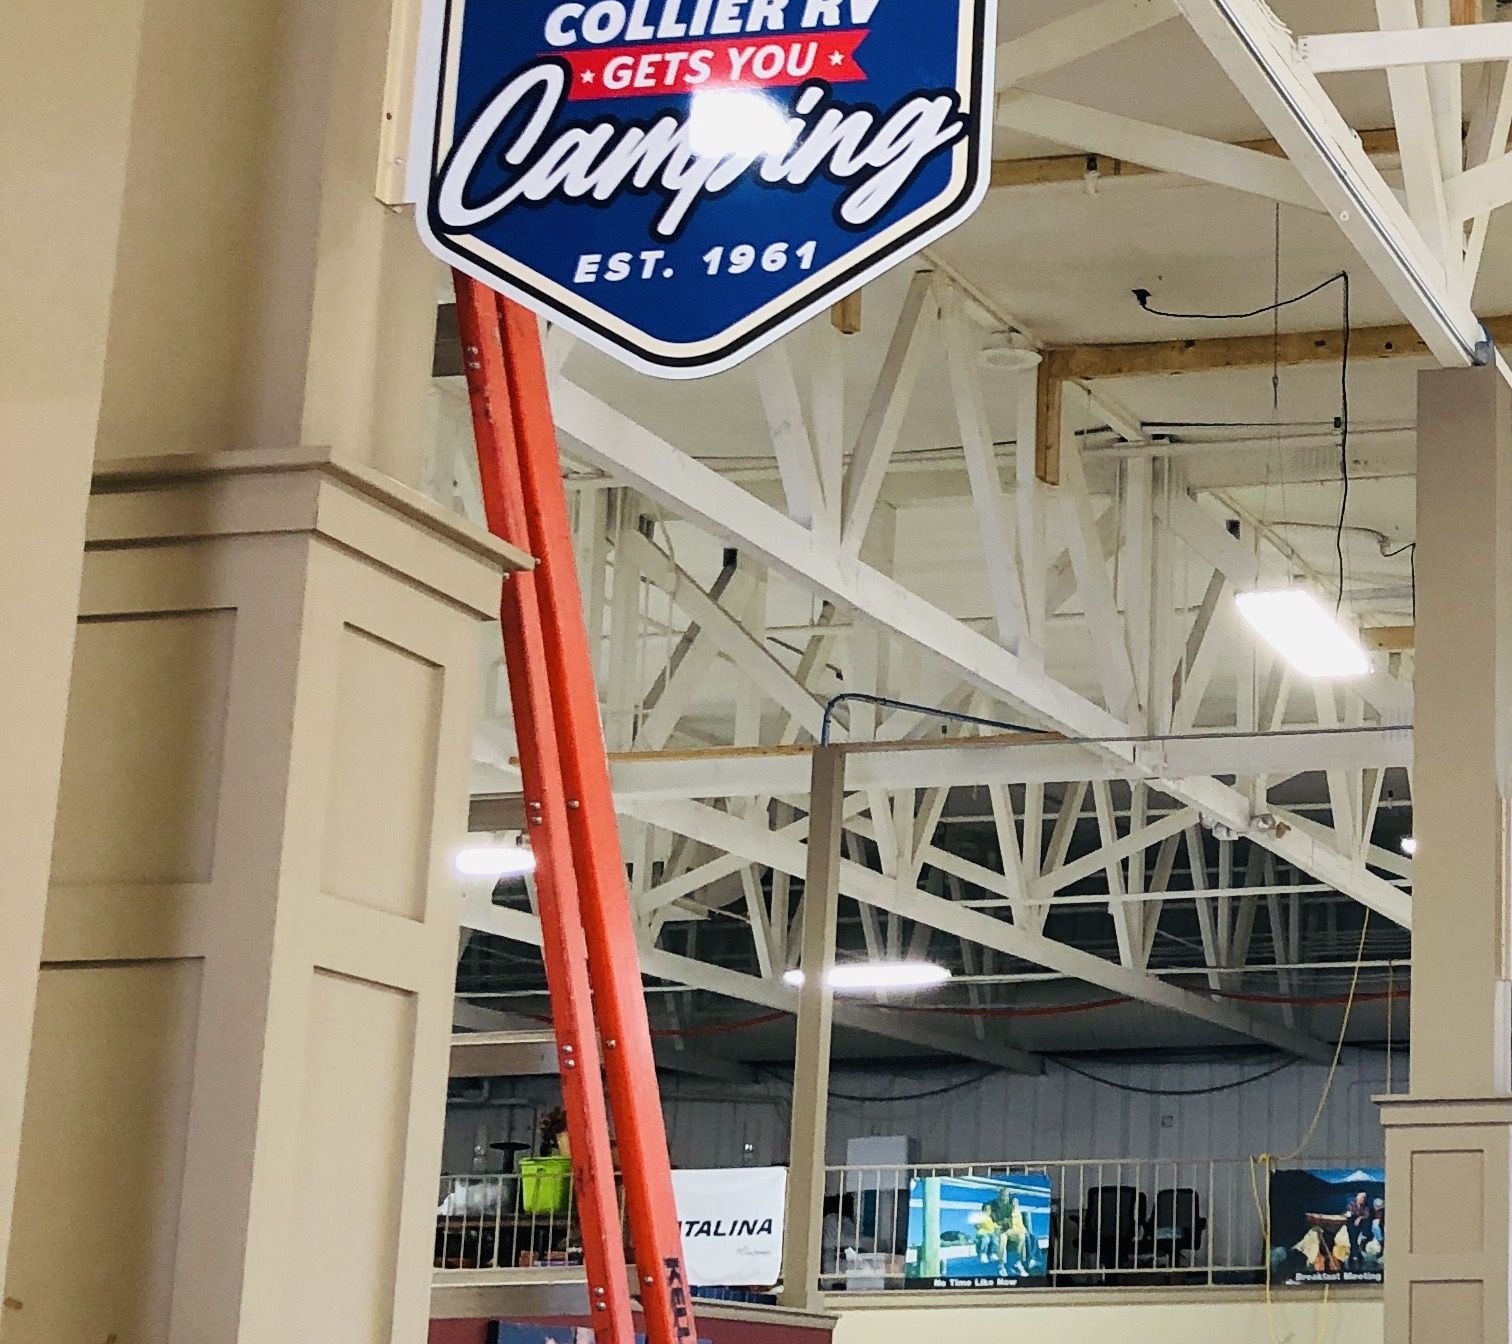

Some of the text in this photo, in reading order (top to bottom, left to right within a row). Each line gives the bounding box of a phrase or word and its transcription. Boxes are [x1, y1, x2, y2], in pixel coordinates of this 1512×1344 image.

[602, 42, 820, 89] GETS YOU
[573, 240, 818, 284] EST. 1961
[678, 1218, 773, 1238] TALINA
